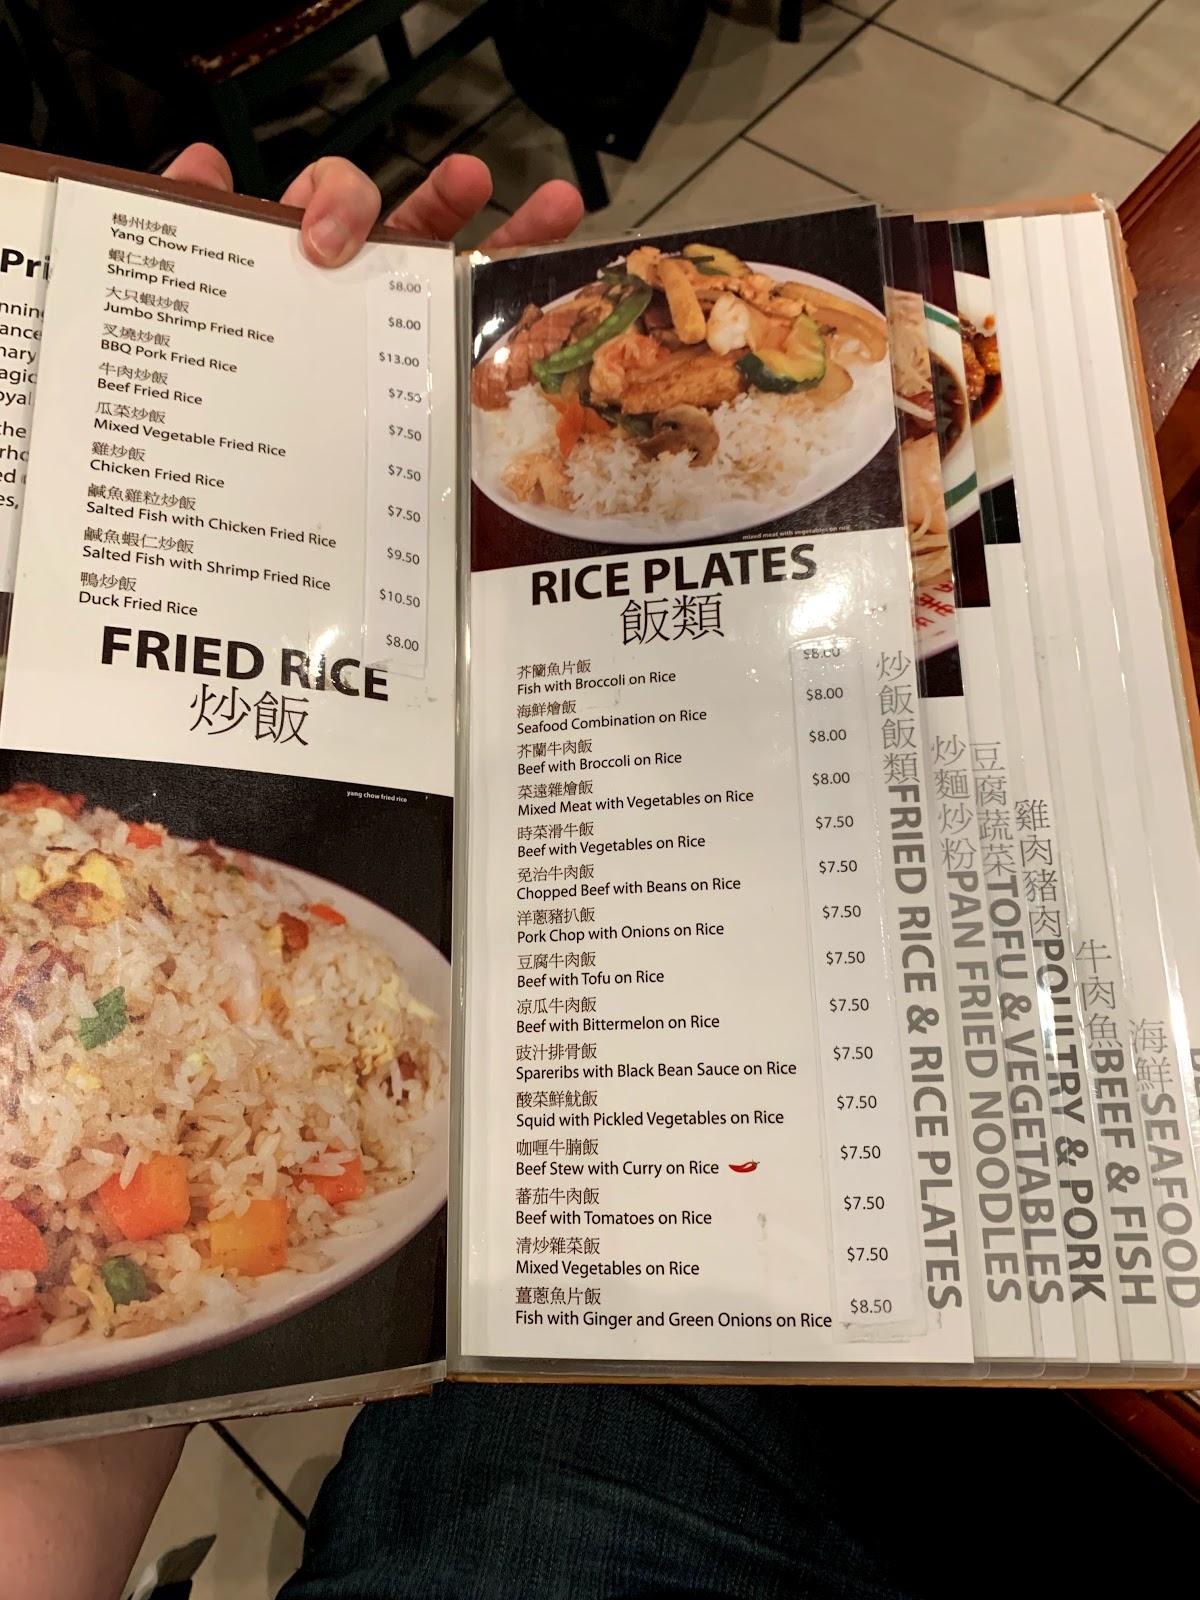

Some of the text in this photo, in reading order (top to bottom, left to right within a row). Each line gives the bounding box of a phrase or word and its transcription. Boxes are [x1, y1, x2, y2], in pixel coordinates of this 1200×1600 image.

[110, 226, 255, 268] Yang Chow Fried Rice
[107, 263, 227, 298] Shrimp Fried Rice
[389, 280, 421, 294] $8.00
[103, 301, 275, 343] Jumbo Shrimp Fried Rice
[388, 317, 421, 331] $8.00
[100, 338, 238, 373] BBQ Pork Fried Rice
[379, 352, 419, 368] $13.00
[93, 418, 286, 457] Mixed Vegetable Fried Rice
[389, 425, 421, 441] $7.50
[85, 501, 336, 549] Salted Fish with Chicken Fried Rice
[387, 547, 420, 565] $9.50
[532, 544, 817, 606] RICE PLATES
[78, 592, 198, 617] Duck Fried Rice
[379, 588, 420, 608] $10.50
[620, 593, 724, 645] 飯類
[386, 634, 419, 652] $8.00
[102, 626, 389, 701] FRIED RICE
[517, 671, 676, 696] Fish with Broccoli on Rice
[806, 687, 843, 701] $8.00
[190, 683, 309, 746] 炒飯
[516, 709, 707, 735] Seafood Combination on Rice
[812, 772, 850, 786] $8.00
[517, 789, 754, 817] Mixed Meat with Vegetables on Rice
[819, 860, 858, 874] $7.50
[516, 877, 741, 902] Chopped Beef with Beans on Rice
[822, 904, 861, 919] $7.50
[517, 922, 724, 944] Pork Chop with Onions on Rice
[517, 952, 596, 969] 豆腐牛肉飯
[829, 998, 869, 1013] $7.50
[516, 1015, 720, 1034] Beef with Bittermelon on Rice
[833, 1046, 873, 1061] $7.50
[888, 784, 962, 1309] FRIED RICE & RICE PLATES
[515, 1061, 797, 1083] Spareribs with Black Bean Sauce on Rice
[946, 870, 1022, 1303] PAN FRIED NOODLES
[986, 875, 1064, 1304] TOFU & VEGETABLES
[837, 1095, 877, 1110] $7.50
[516, 1111, 784, 1131] Squid with Pickled Vegetables on Rice
[840, 1145, 880, 1160] $7.50
[1055, 1135, 1089, 1167] &
[516, 1161, 719, 1179] Beef Stew with Curry on Rice
[1091, 1049, 1156, 1304] BEEF & FISH
[1141, 1093, 1200, 1308] SEAFOOD
[1060, 1179, 1106, 1303] PORK
[850, 1299, 892, 1315] $8.50
[515, 1311, 832, 1330] Fish with Ginger and Green Onions on Rice
